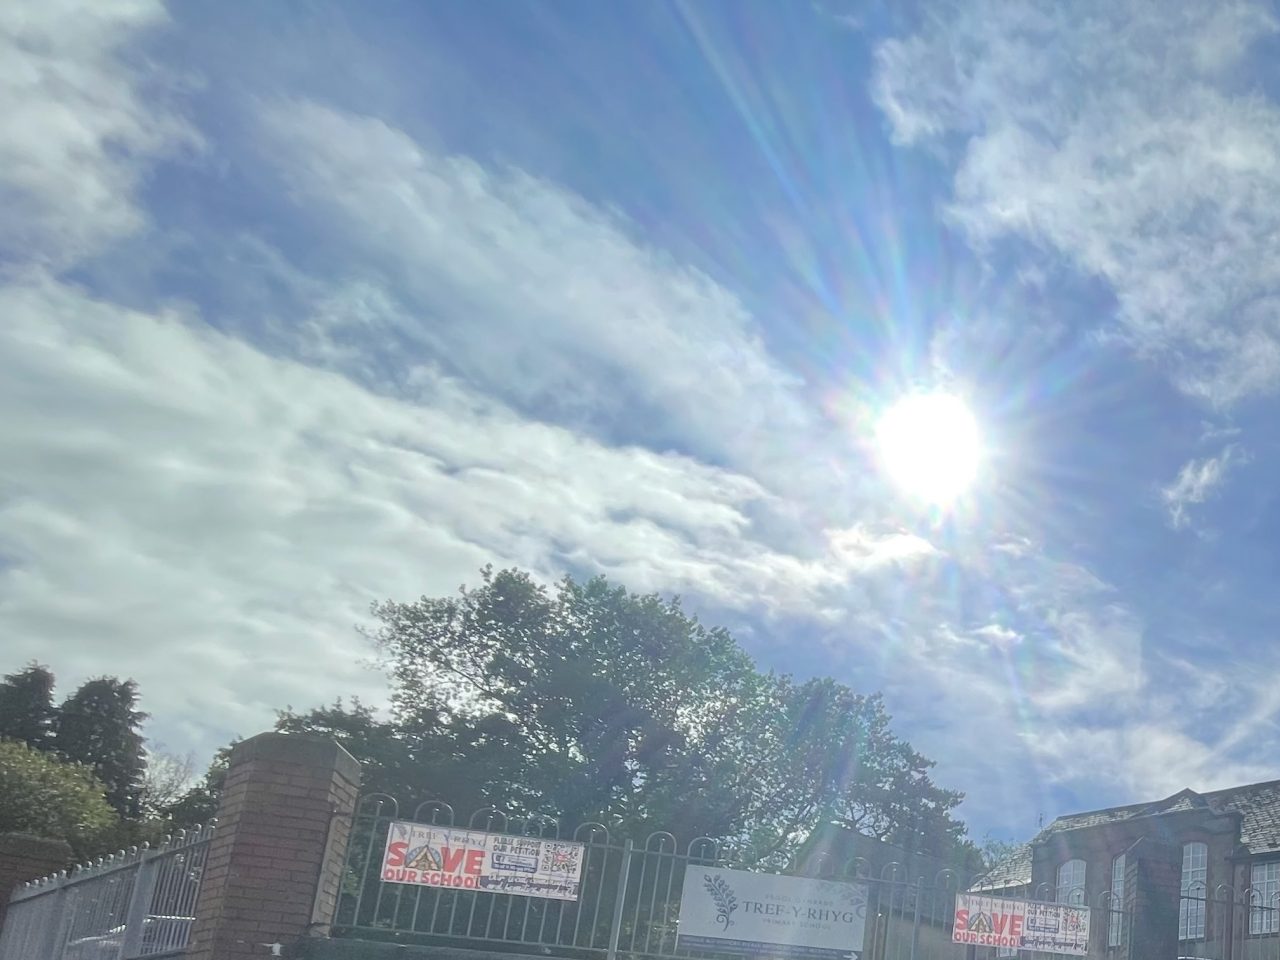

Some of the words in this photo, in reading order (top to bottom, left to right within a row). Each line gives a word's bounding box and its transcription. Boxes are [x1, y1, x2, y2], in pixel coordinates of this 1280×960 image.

[386, 841, 486, 875] SAVE
[510, 847, 541, 856] PETITION
[384, 868, 417, 882] OUR
[421, 871, 481, 889] SCHOOL
[743, 900, 853, 923] TREF-Y-RHYG
[956, 909, 1024, 935] SAVE
[954, 932, 976, 943] OUR
[980, 934, 1021, 947] SCHOOL
